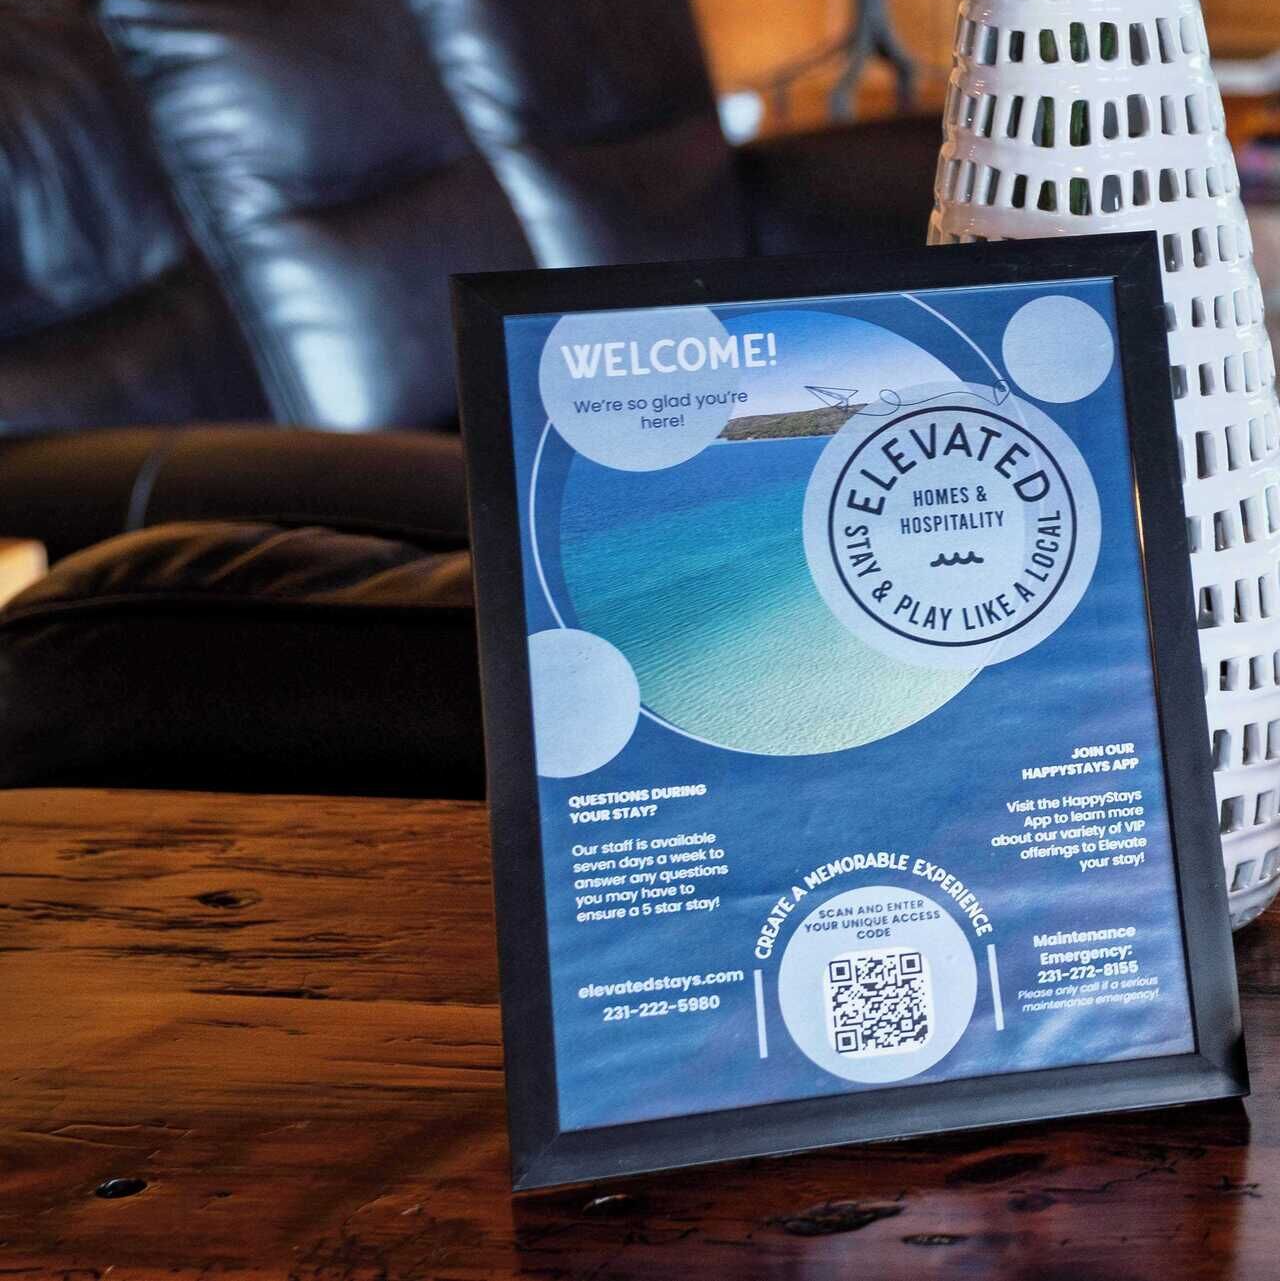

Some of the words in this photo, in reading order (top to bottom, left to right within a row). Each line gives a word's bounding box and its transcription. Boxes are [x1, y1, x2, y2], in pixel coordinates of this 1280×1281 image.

[560, 332, 777, 379] WELCOME!
[574, 399, 623, 413] We're
[627, 398, 647, 410] so
[652, 393, 691, 413] glad
[696, 391, 748, 409] you're
[641, 414, 684, 429] here!
[847, 423, 1049, 516] ELEVATED
[913, 487, 969, 507] HOMES
[976, 485, 987, 501] &
[901, 510, 1004, 534] HOSPITALITY
[845, 525, 881, 577] STAY
[872, 580, 892, 602] &
[893, 594, 952, 631] PLAY
[962, 594, 1016, 630] LIKE
[1013, 582, 1035, 602] A
[1025, 510, 1061, 582] LOCAL
[1071, 746, 1103, 759] JOIN
[1105, 743, 1134, 755] OUR
[1022, 761, 1110, 780] HAPPYSTAYS
[1112, 758, 1139, 770] APP
[569, 789, 649, 808] QUESTIONS
[651, 784, 707, 800] DURING
[1007, 800, 1034, 813] Visit
[1038, 798, 1059, 809] the
[1063, 790, 1142, 808] HappyStays
[570, 810, 610, 823] YOUR
[612, 805, 658, 820] STAY?
[1024, 814, 1051, 829] App
[1054, 813, 1068, 824] to
[1071, 810, 1105, 822] learn
[1108, 806, 1143, 817] more
[572, 844, 598, 856] Our
[601, 839, 633, 854] staff
[636, 839, 648, 849] is
[651, 832, 716, 849] available
[991, 833, 1033, 846] about
[1035, 831, 1057, 841] our
[1060, 825, 1105, 840] variety
[1109, 823, 1122, 834] of
[1125, 820, 1145, 832] VIP
[1020, 844, 1079, 859] offerings
[1082, 842, 1096, 853] to
[1099, 836, 1147, 851] Elevate
[573, 859, 615, 873] seven
[619, 854, 653, 870] days
[657, 855, 667, 864] a
[671, 849, 706, 862] week
[710, 848, 724, 859] to
[1080, 857, 1109, 872] your
[1112, 852, 1144, 867] stay!
[575, 874, 626, 890] answer
[630, 871, 656, 885] any
[660, 865, 728, 883] questions
[576, 894, 602, 909] you
[606, 889, 638, 903] may
[641, 887, 676, 899] have
[680, 884, 695, 895] to
[755, 896, 795, 959] CREATE
[791, 885, 808, 902] A
[803, 852, 909, 889] MEMORABLE
[912, 859, 992, 936] EXPERIENCE
[576, 906, 626, 922] ensure
[629, 906, 639, 915] a
[642, 904, 651, 915] 5
[655, 901, 682, 914] star
[685, 896, 720, 912] stay!
[819, 907, 853, 919] SCAN
[857, 903, 883, 914] AND
[887, 899, 924, 911] ENTER
[805, 921, 838, 932] YOUR
[842, 916, 888, 929] UNIQUE
[892, 910, 940, 923] ACCESS
[857, 928, 891, 940] CODE
[1033, 927, 1136, 947] Maintenance
[1040, 944, 1132, 966] Emergency:
[1038, 960, 1139, 983] 231-272-8155
[578, 970, 744, 999] elevatedstays.com
[1018, 987, 1052, 1000] Please
[1056, 985, 1078, 996] only
[1080, 982, 1099, 993] call
[1102, 980, 1108, 989] if
[1111, 981, 1118, 989] a
[1121, 976, 1158, 988] serious
[603, 995, 720, 1021] 231-222-5980
[1023, 996, 1094, 1012] maintenance
[1096, 988, 1159, 1005] emergency!
